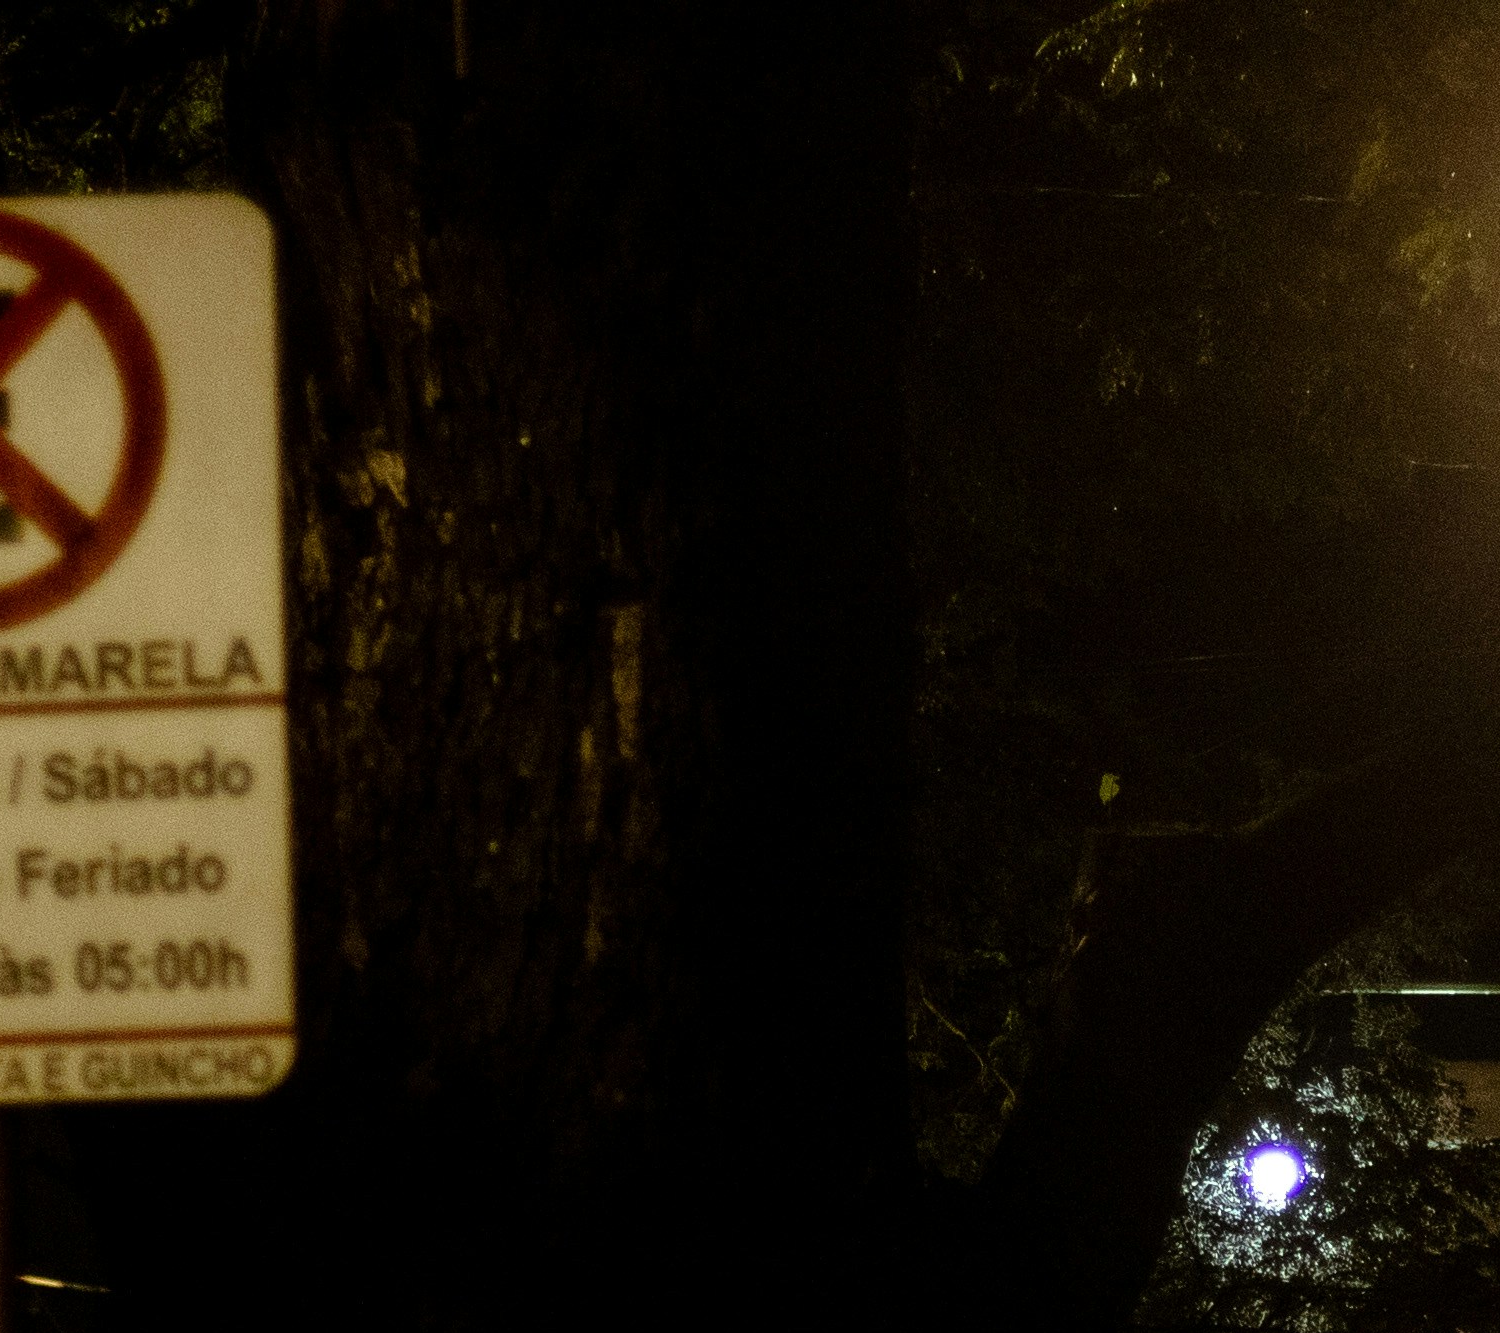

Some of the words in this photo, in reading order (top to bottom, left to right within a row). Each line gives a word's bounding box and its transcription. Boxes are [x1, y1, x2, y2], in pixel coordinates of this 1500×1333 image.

[41, 746, 254, 804] Sábado
[15, 841, 228, 900] Feriado
[74, 937, 250, 993] 05:00h
[43, 1048, 67, 1093] E
[79, 1044, 275, 1092] GUINCHO
